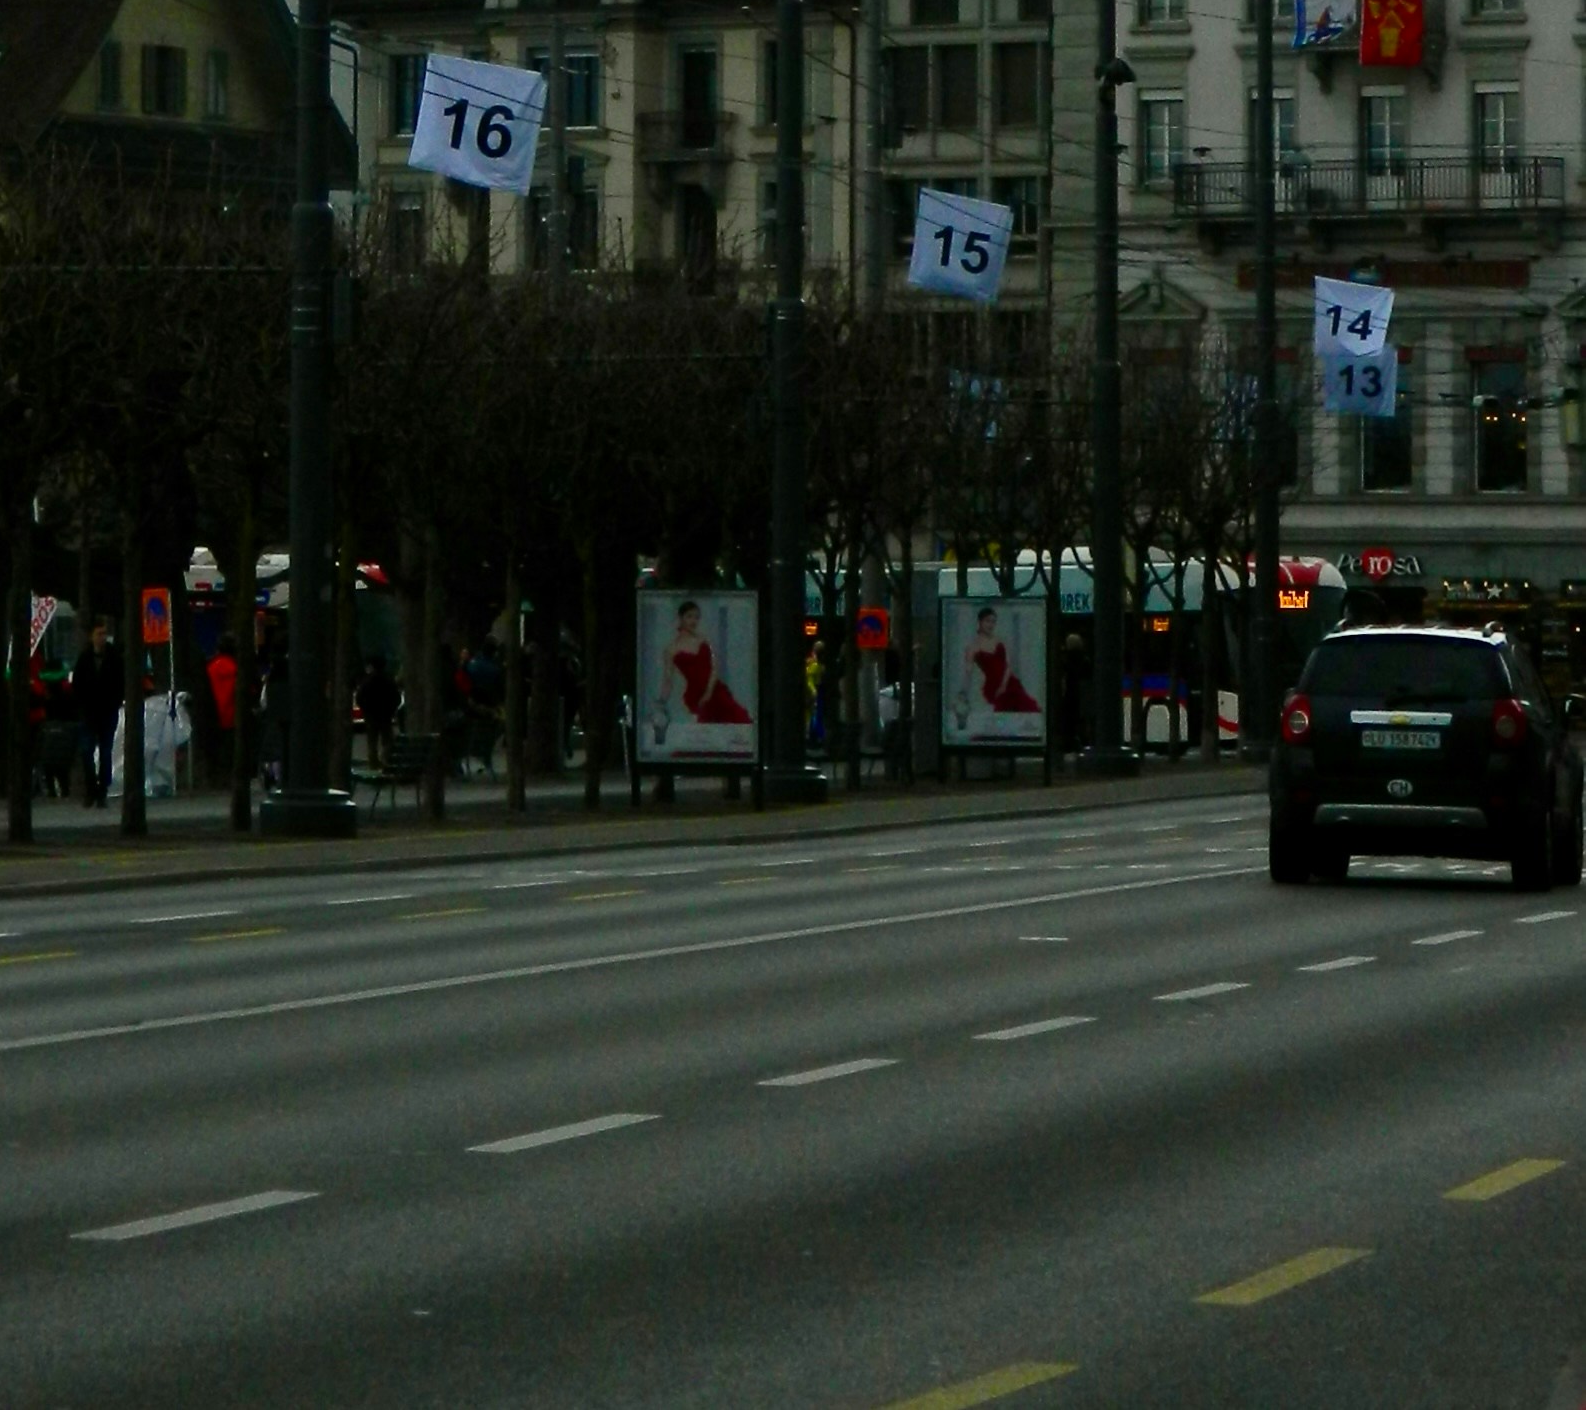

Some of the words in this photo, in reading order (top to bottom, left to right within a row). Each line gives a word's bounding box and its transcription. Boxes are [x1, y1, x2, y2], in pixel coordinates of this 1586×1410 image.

[443, 98, 516, 160] 16
[933, 223, 991, 275] 15
[1325, 304, 1374, 341] 14
[1338, 364, 1383, 398] 13
[1390, 780, 1409, 795] CH
